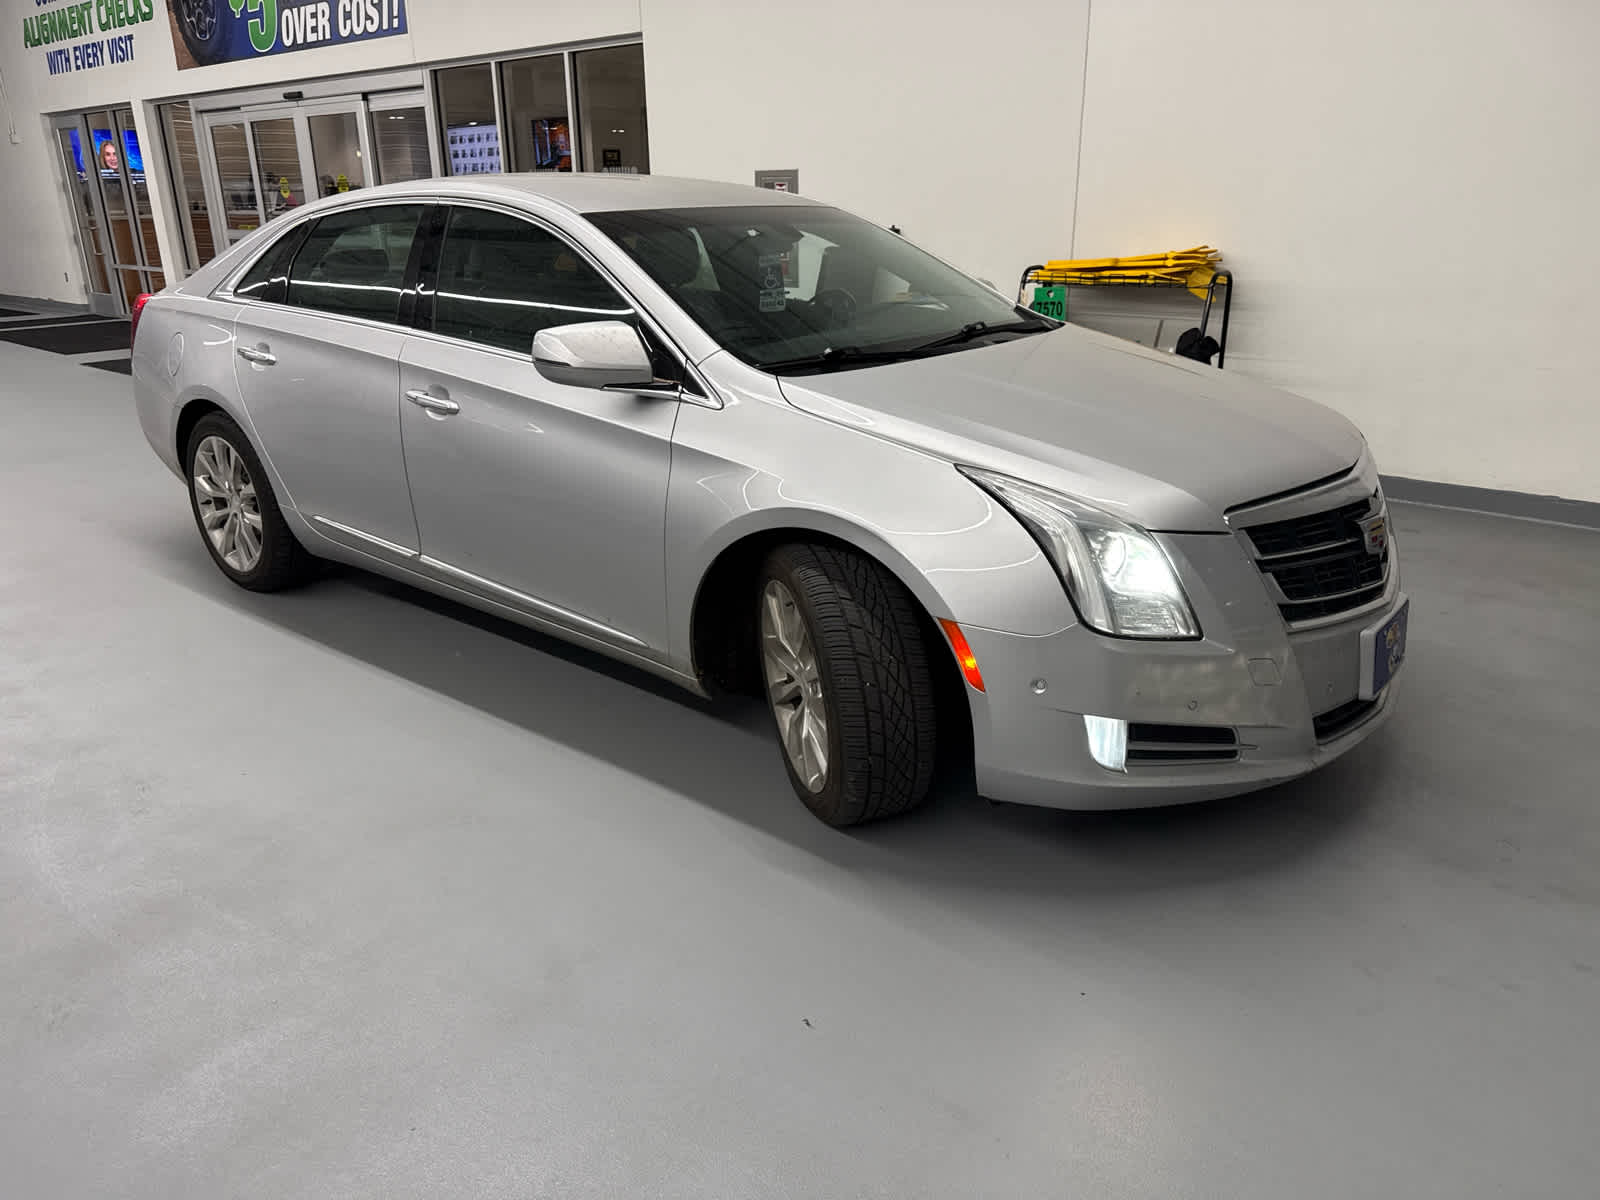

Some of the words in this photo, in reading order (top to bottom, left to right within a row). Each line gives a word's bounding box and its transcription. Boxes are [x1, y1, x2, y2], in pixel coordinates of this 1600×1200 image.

[23, 1, 94, 49] ALIGNMENT
[95, 0, 153, 32] CHECKS
[281, 1, 332, 47] OVER
[338, 0, 399, 38] COST!
[46, 48, 72, 75] WITH
[72, 40, 105, 71] EVERY
[106, 34, 134, 64] VISIT
[1036, 301, 1063, 316] 7570
